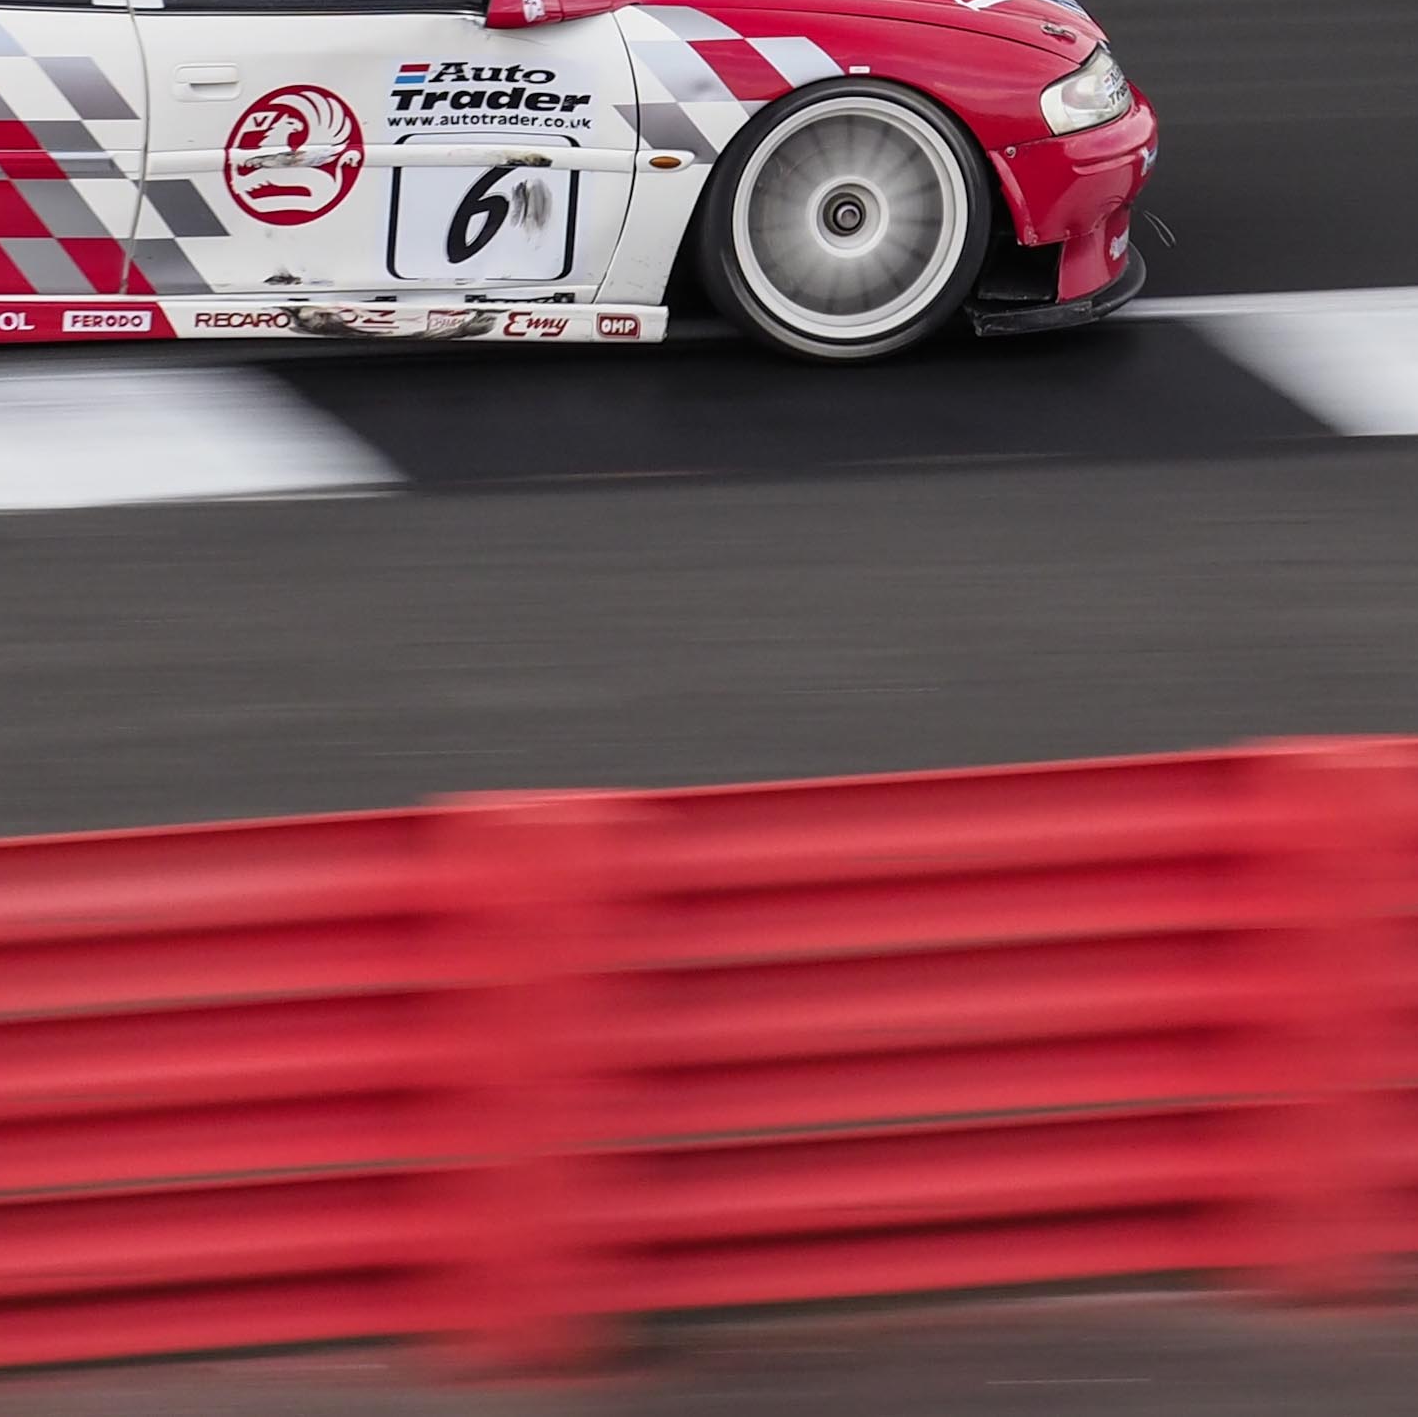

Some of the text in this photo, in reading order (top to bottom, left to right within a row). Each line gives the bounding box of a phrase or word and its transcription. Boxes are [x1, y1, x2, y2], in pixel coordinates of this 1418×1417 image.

[428, 61, 557, 84] Auto
[390, 87, 592, 113] Trader
[387, 114, 593, 130] www.autotrader.co.uk
[446, 162, 519, 264] 6
[71, 316, 142, 328] FERODO
[194, 312, 292, 329] RECARO
[601, 318, 636, 334] OMP
